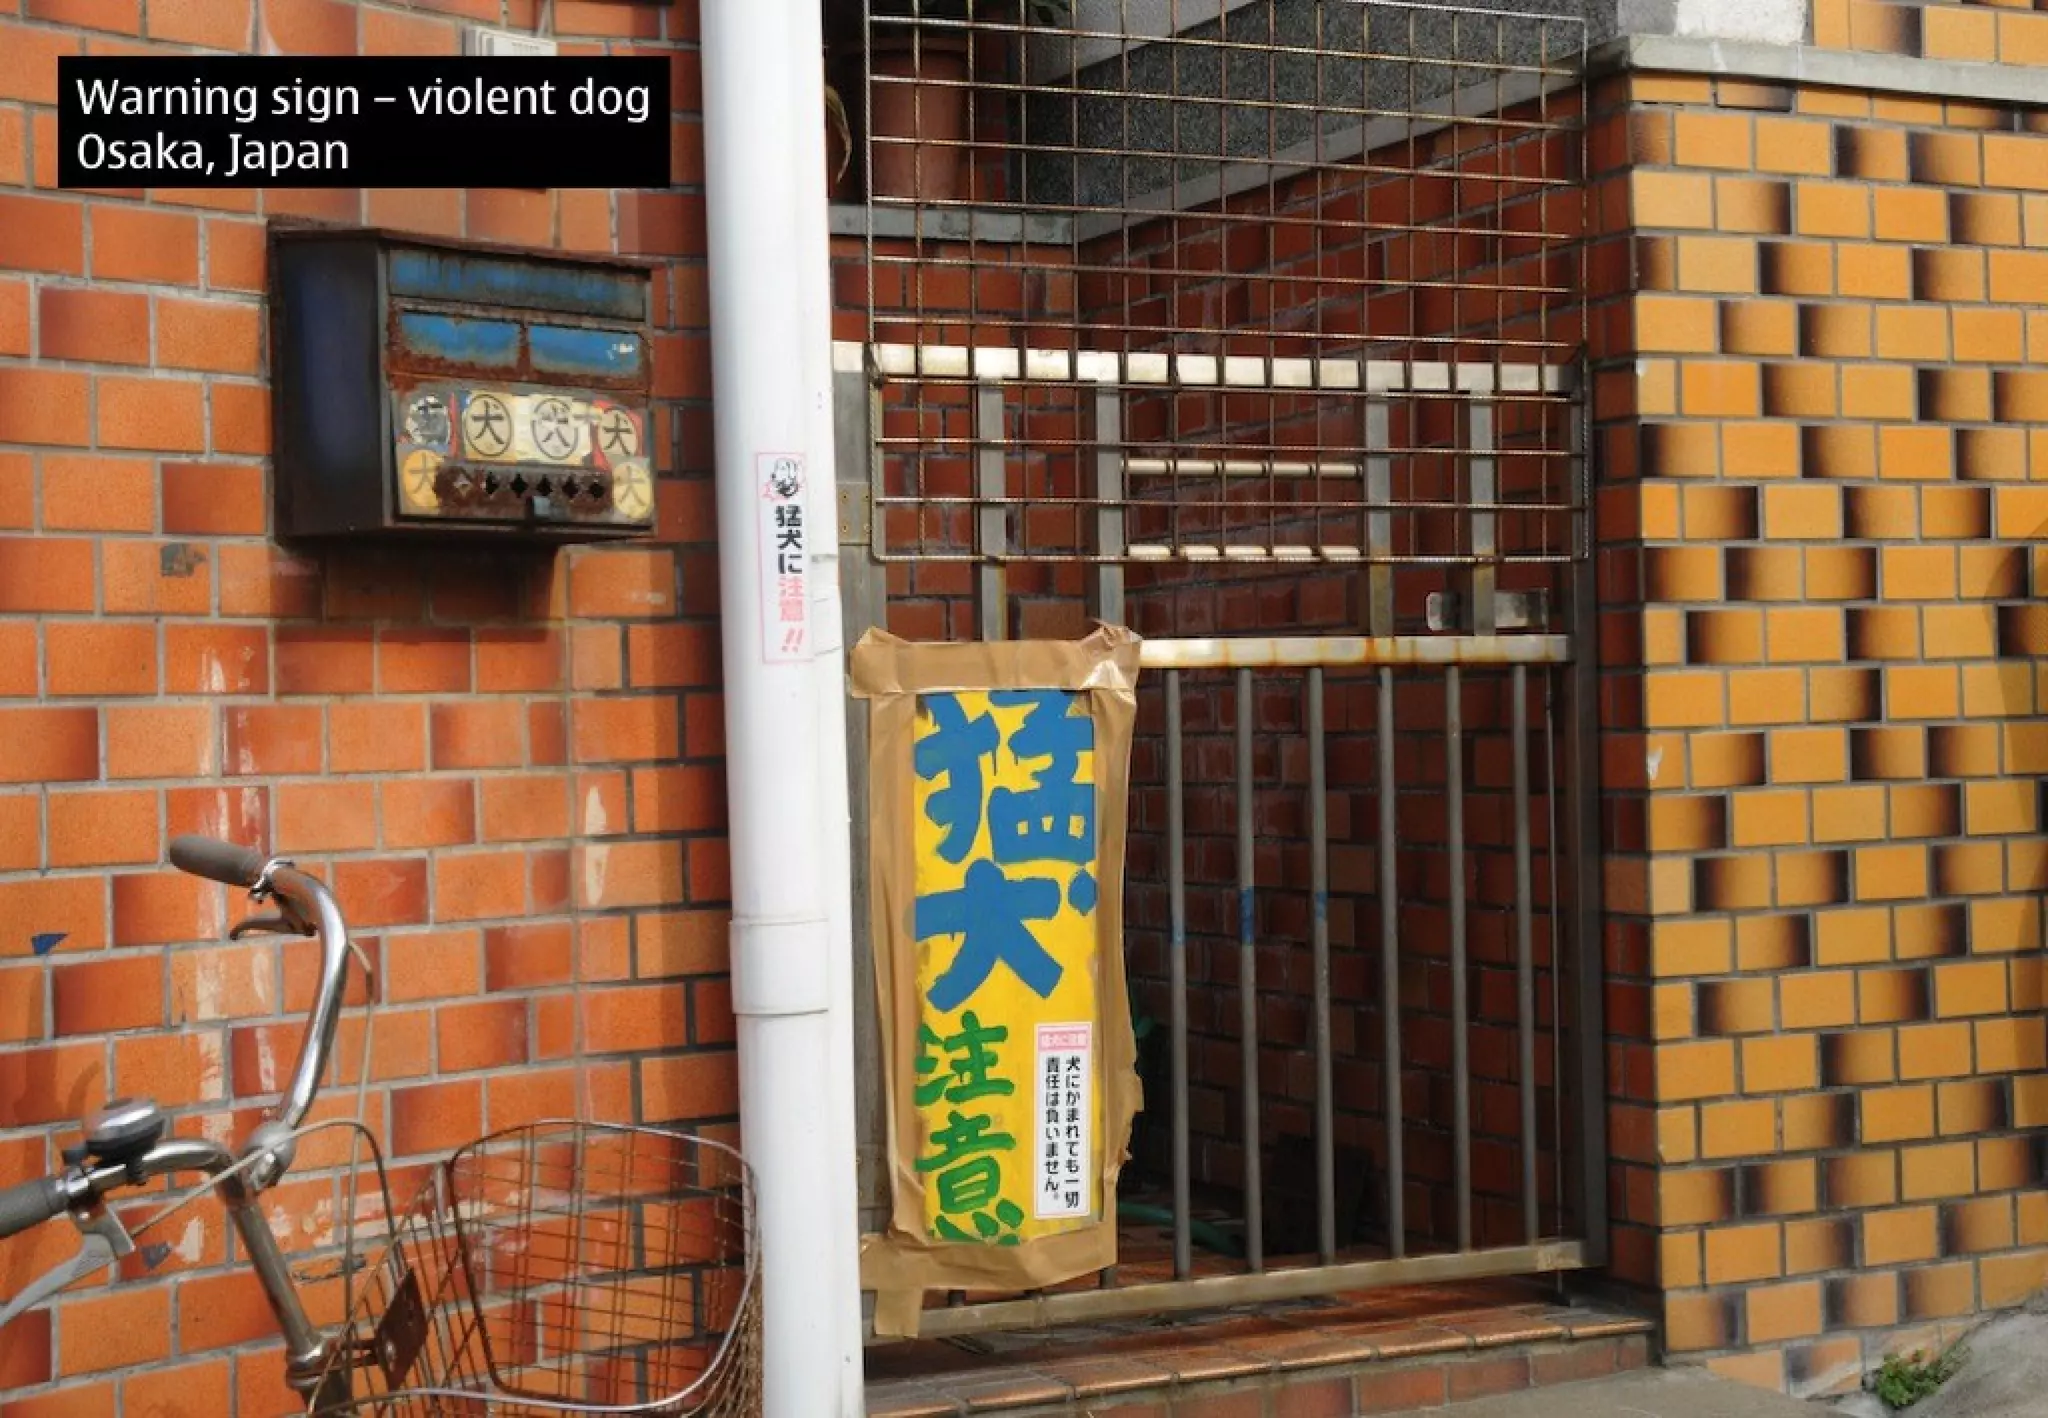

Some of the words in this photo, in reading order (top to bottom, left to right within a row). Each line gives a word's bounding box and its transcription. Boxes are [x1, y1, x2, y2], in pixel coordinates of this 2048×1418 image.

[472, 400, 505, 445] 犬
[603, 413, 632, 456] 犬
[1045, 1056, 1060, 1200] 責任は負いません。
[1065, 1055, 1080, 1208] 犬にかまれても一切
